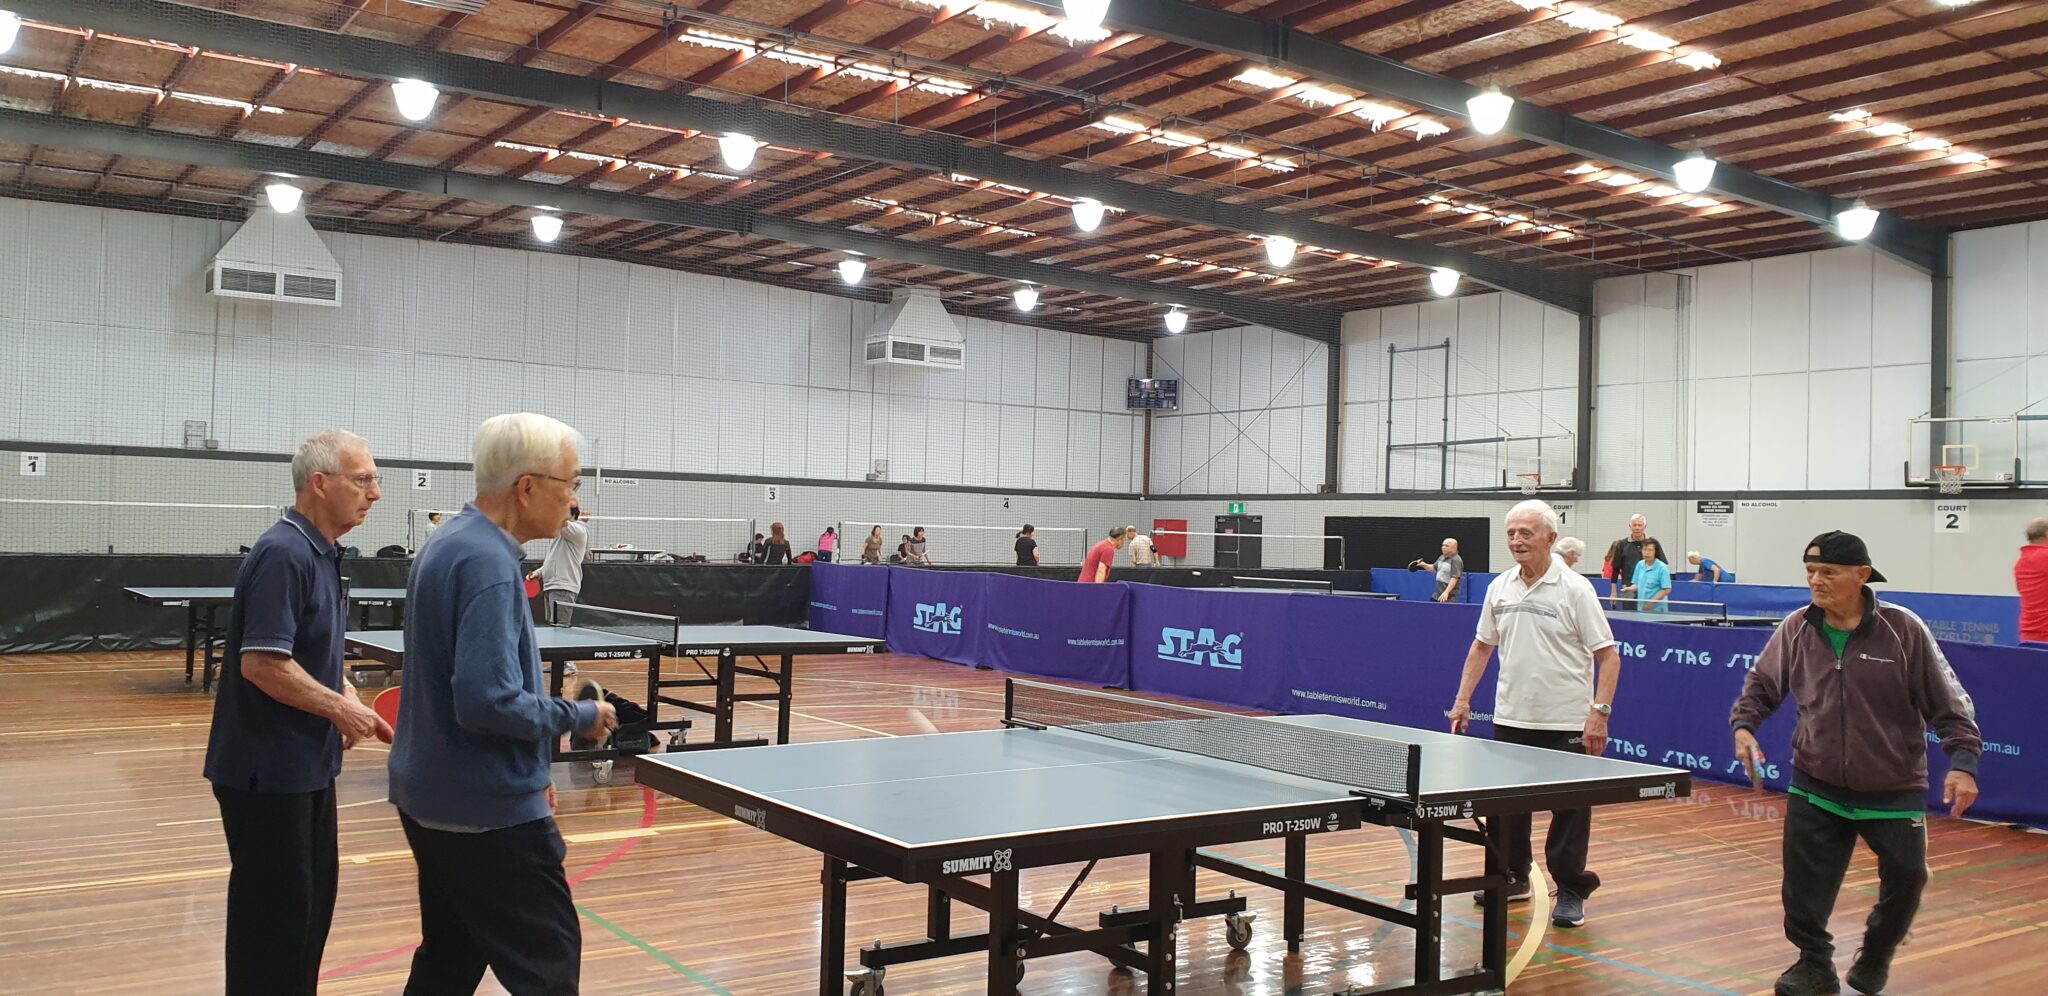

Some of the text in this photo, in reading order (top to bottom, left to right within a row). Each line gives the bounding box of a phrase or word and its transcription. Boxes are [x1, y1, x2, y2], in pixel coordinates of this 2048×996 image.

[28, 461, 36, 472] 1
[417, 477, 426, 487] 2
[769, 491, 776, 500] 3
[1559, 511, 1566, 524] 1
[1945, 513, 1959, 529] 2
[913, 602, 962, 635] STAG
[1926, 620, 1999, 633] TABLE TENNIS
[1157, 627, 1243, 670] STAG
[1614, 640, 1647, 658] TAG
[1661, 648, 1712, 666] STAG
[1291, 688, 1387, 711] www.tabletennisworld.com.au
[1662, 750, 1712, 770] STAG
[1727, 760, 1780, 780] SAG
[1426, 805, 1458, 818] T-250W
[1263, 817, 1321, 834] PRO T-250W
[942, 855, 993, 875] SUMMIT
